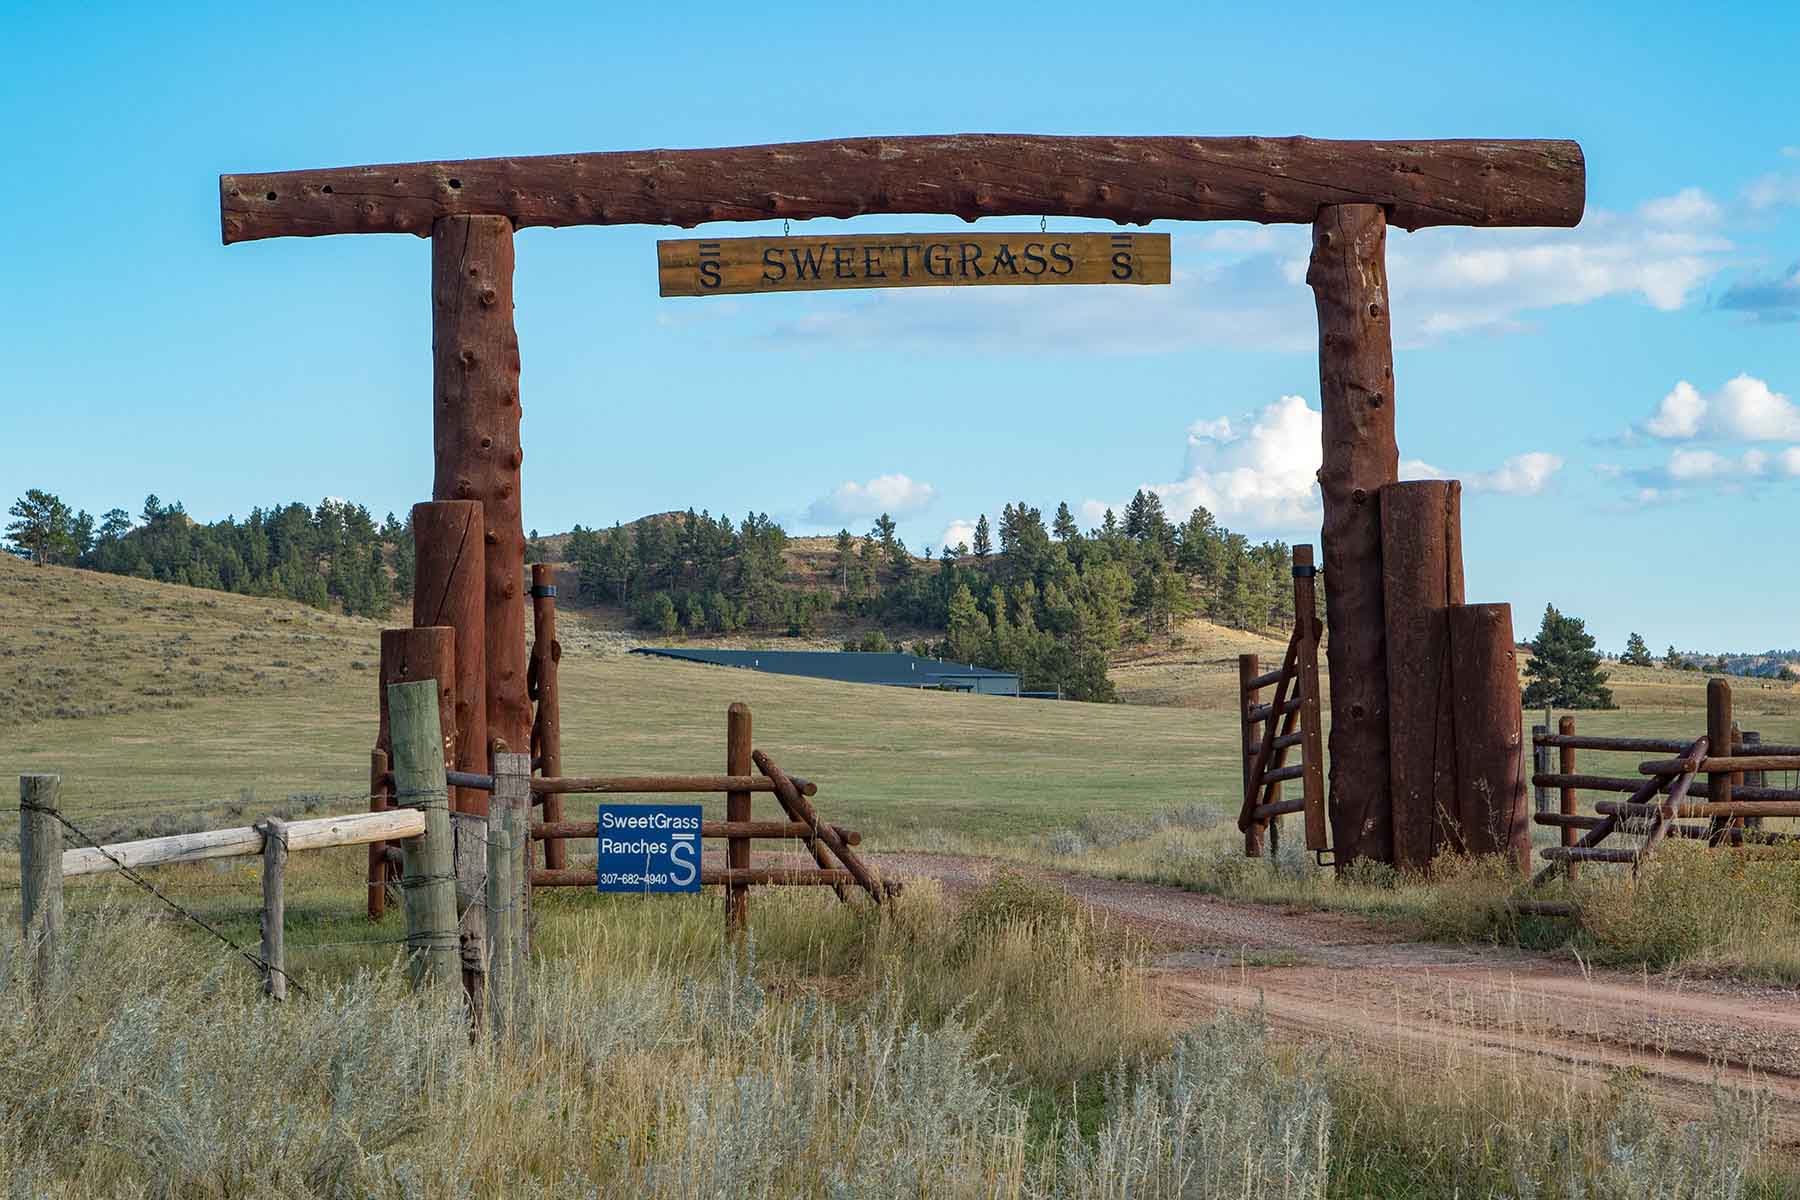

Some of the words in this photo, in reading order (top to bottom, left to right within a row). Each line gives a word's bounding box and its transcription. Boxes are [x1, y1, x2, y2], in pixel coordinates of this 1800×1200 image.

[761, 242, 1075, 281] SWEETGRASS
[602, 812, 699, 829] SweetGrass
[601, 838, 668, 854] Ranches
[600, 873, 668, 885] 307-682-4940
